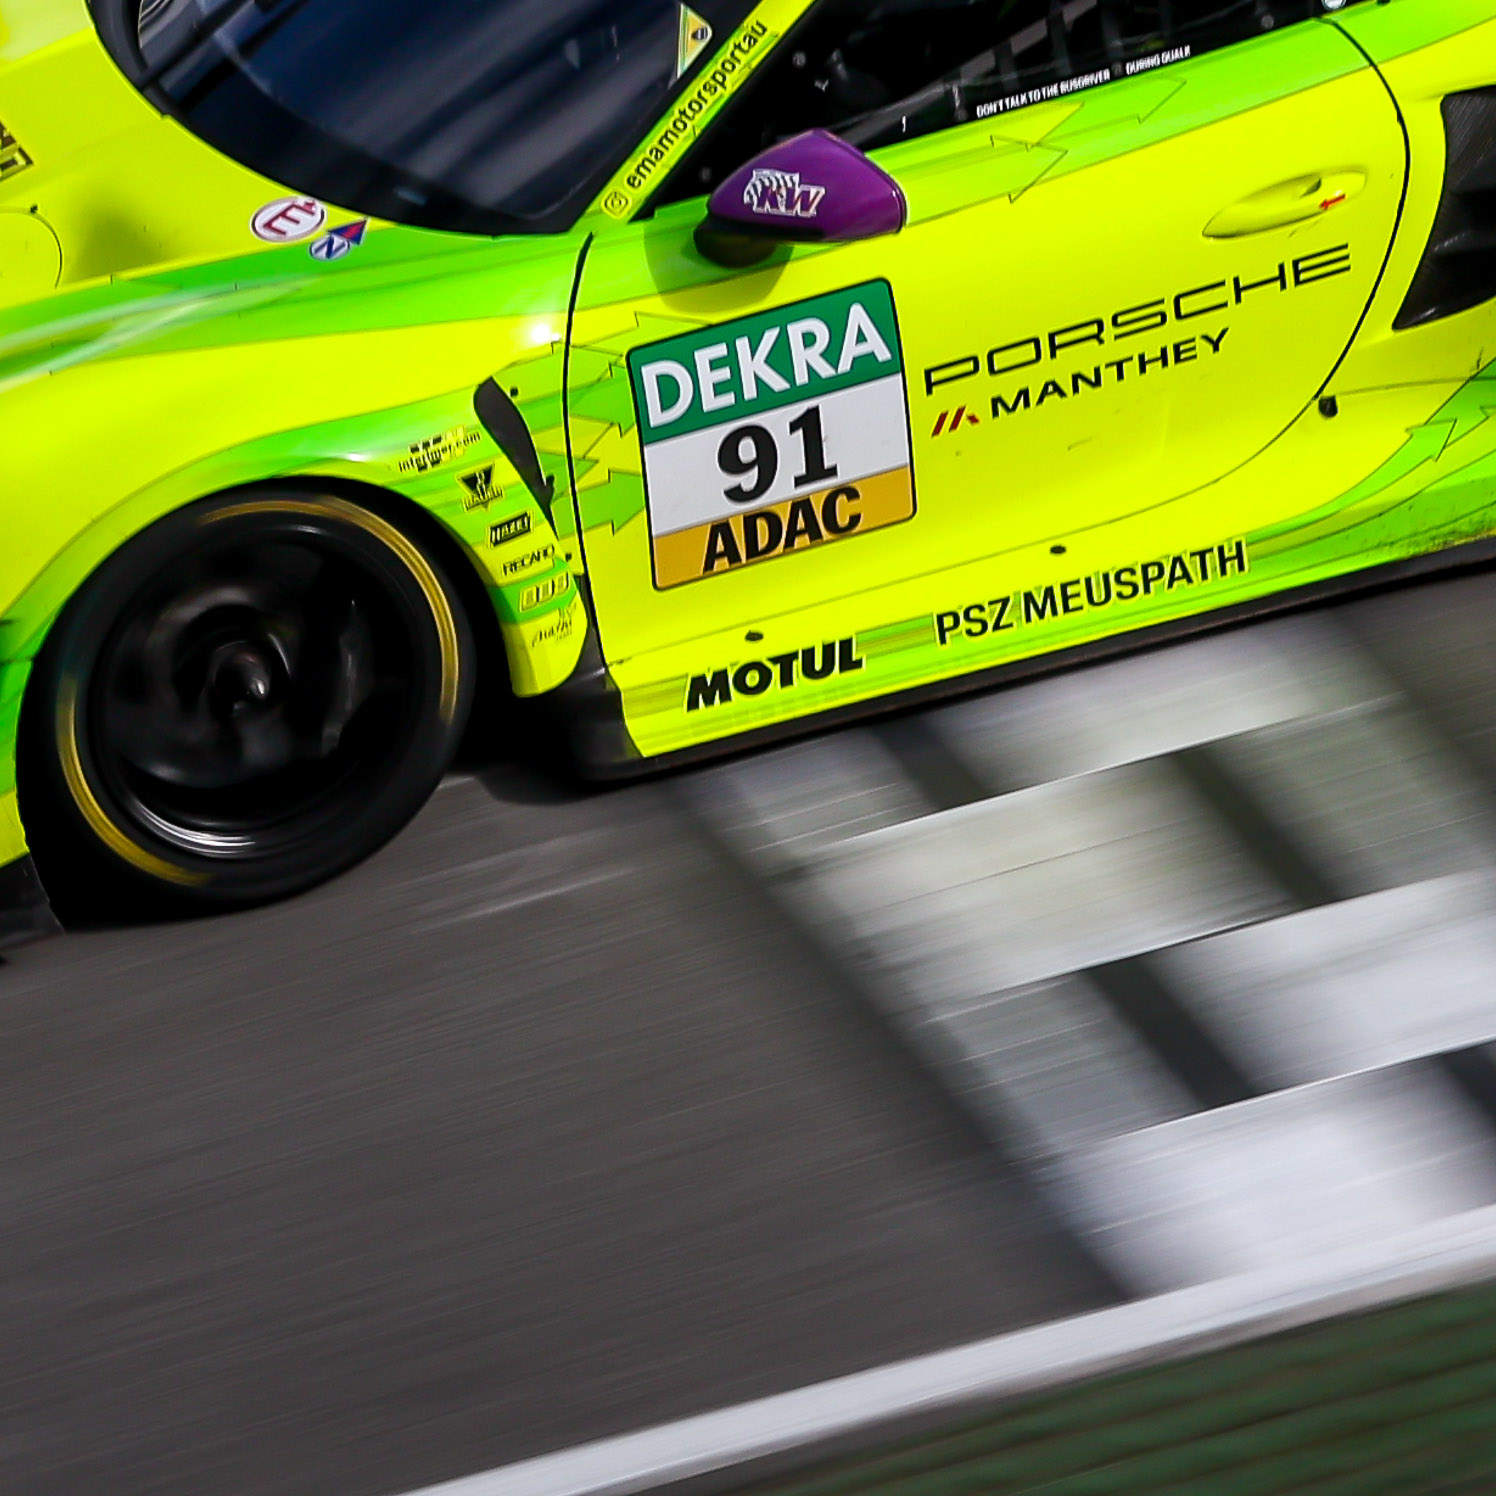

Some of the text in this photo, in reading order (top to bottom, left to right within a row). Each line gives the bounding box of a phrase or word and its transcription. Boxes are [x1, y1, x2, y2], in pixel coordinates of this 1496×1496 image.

[1005, 93, 1028, 111] TALK
[1028, 87, 1041, 104] TO
[1041, 82, 1059, 100] THE
[640, 301, 892, 429] DEKRA
[923, 242, 1352, 397] PORSCHE
[991, 328, 1230, 419] MANTHEY
[717, 405, 839, 505] 91
[702, 487, 863, 573] ADAC
[935, 541, 1248, 646] PSZ MEUSPATH
[686, 636, 865, 712] MOTUL
